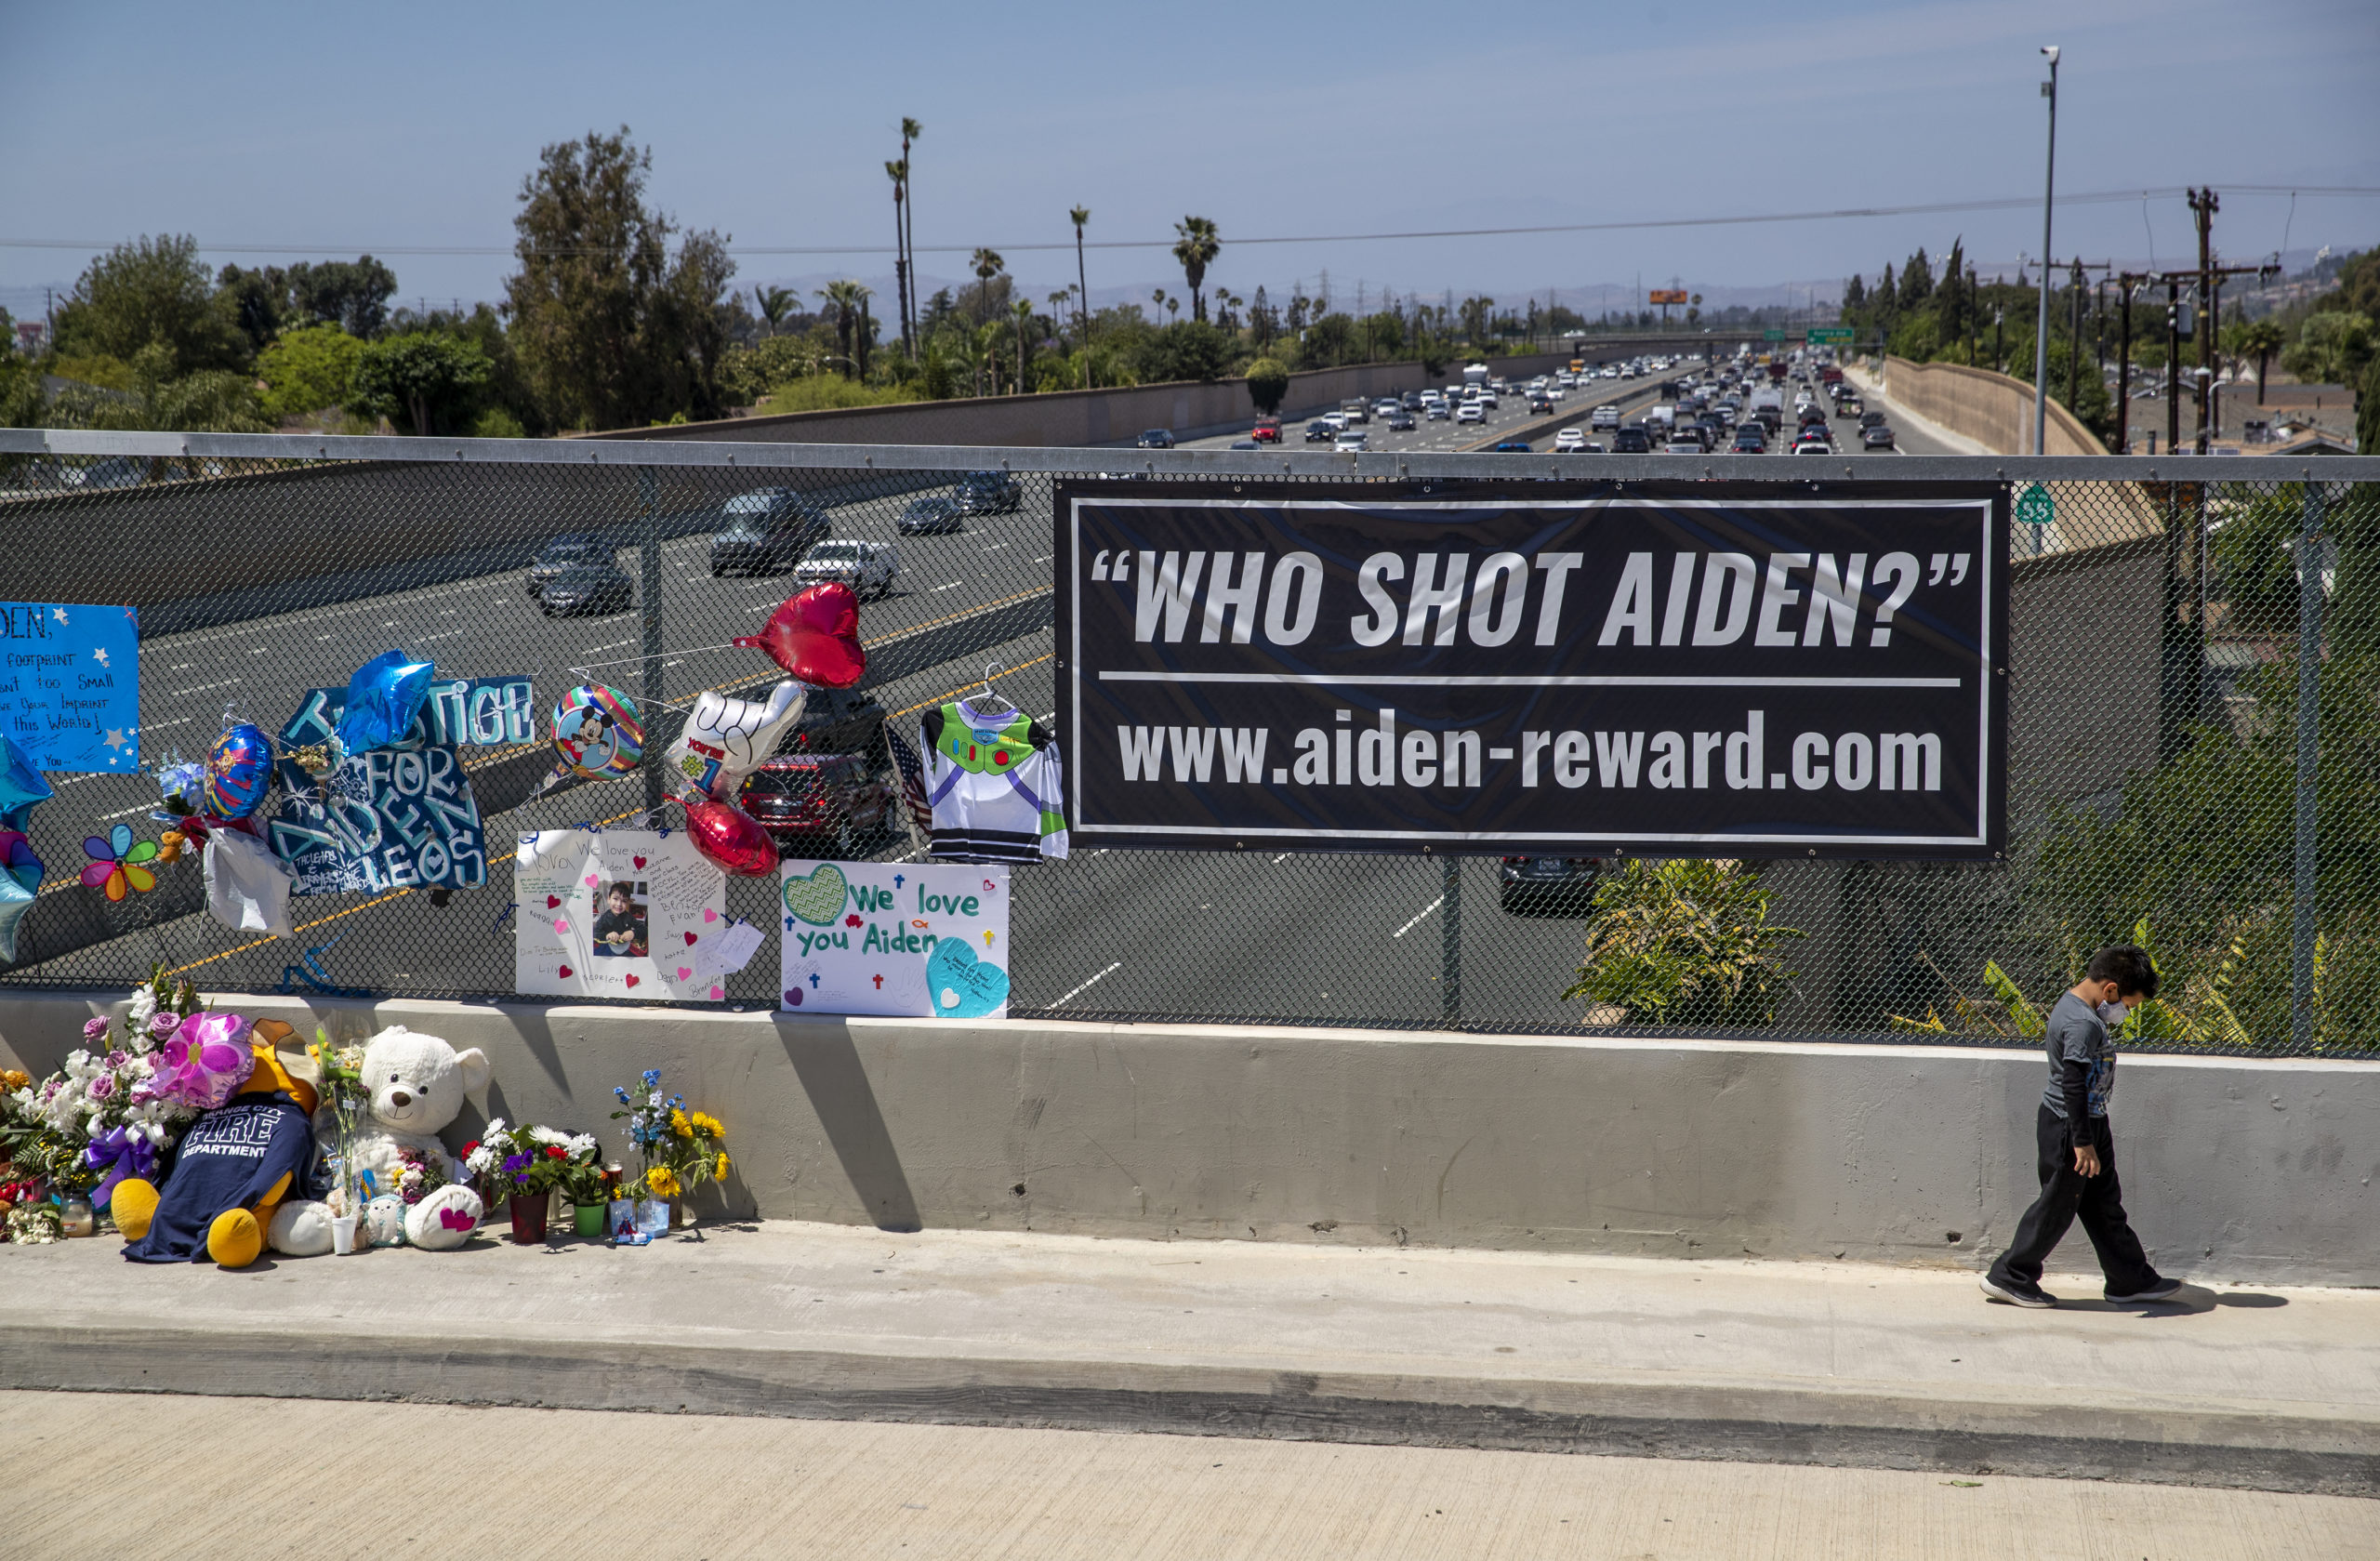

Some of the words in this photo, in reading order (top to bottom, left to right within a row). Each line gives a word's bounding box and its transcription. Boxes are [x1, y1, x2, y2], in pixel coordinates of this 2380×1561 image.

[1091, 549, 1324, 646] “WHO
[1350, 549, 1584, 647] SHOT
[1597, 551, 1971, 647] AIDEN?”
[1117, 708, 1941, 791] www.aiden-reward.com
[364, 747, 456, 798] FOR
[681, 754, 723, 795] #1
[575, 839, 601, 856] We
[605, 840, 628, 855] love
[631, 847, 654, 856] you
[849, 884, 894, 913] We
[919, 883, 979, 916] love
[797, 931, 849, 958] you
[862, 920, 938, 955] Aiden
[185, 1113, 282, 1148] FIRE
[182, 1144, 269, 1159] DEPARTMENT
